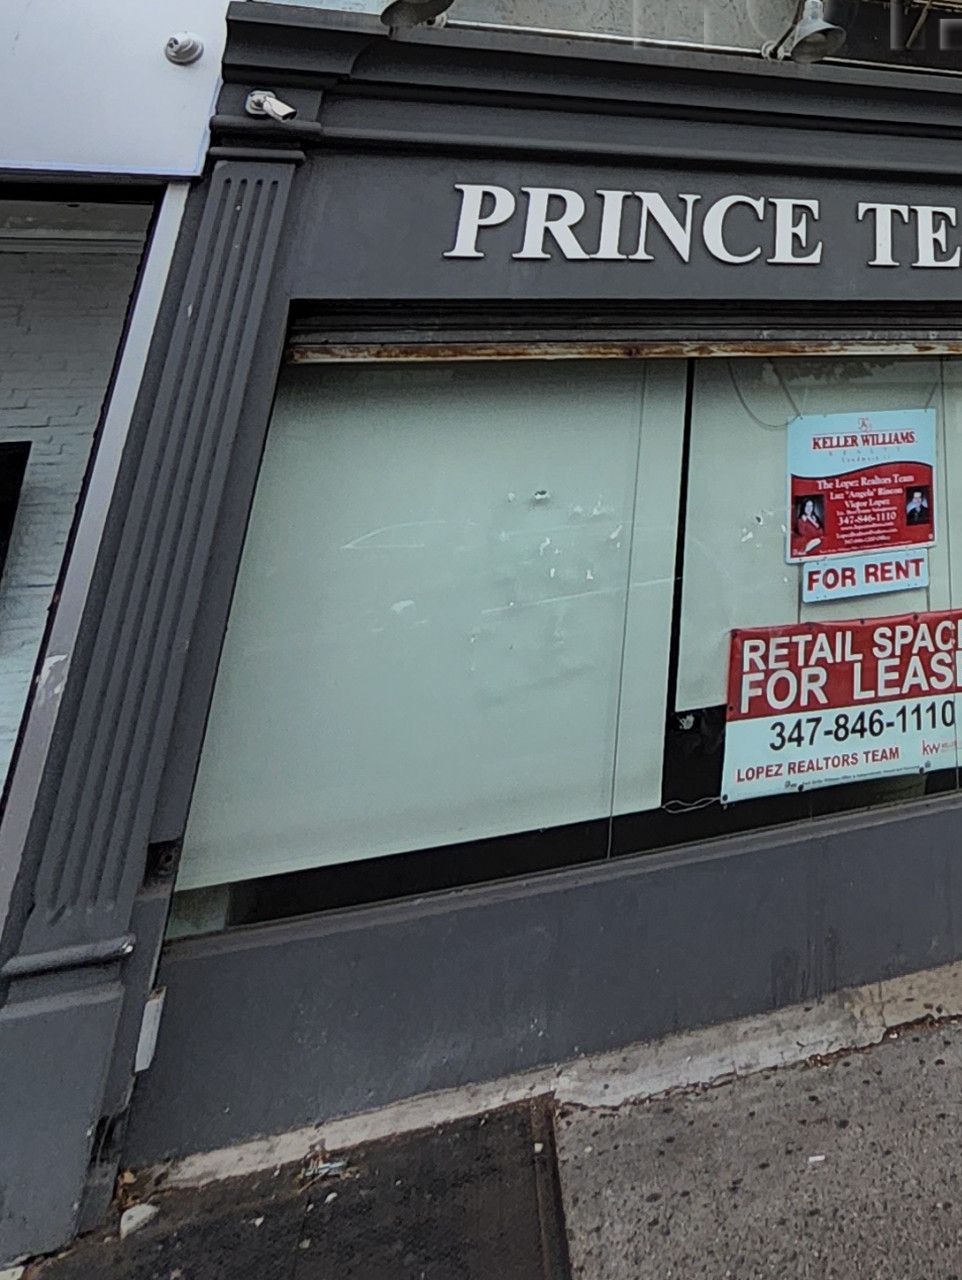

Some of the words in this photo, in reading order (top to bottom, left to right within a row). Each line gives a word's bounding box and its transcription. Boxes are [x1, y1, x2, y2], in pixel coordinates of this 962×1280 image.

[443, 183, 823, 265] PRINCE
[812, 434, 859, 450] KELLER
[860, 431, 916, 447] WILLIAMS
[817, 480, 834, 490] The
[835, 478, 860, 489] Lopez
[892, 473, 915, 484] Team
[838, 511, 898, 526] 347-846-1110
[807, 566, 857, 592] FOR
[864, 558, 925, 584] RENT
[742, 630, 864, 673] RETAIL
[740, 667, 829, 715] FOR
[769, 700, 956, 751] 347-846-1110
[736, 765, 783, 784] LOPEZ
[787, 752, 859, 776] REALTORS
[863, 746, 900, 763] TEAM
